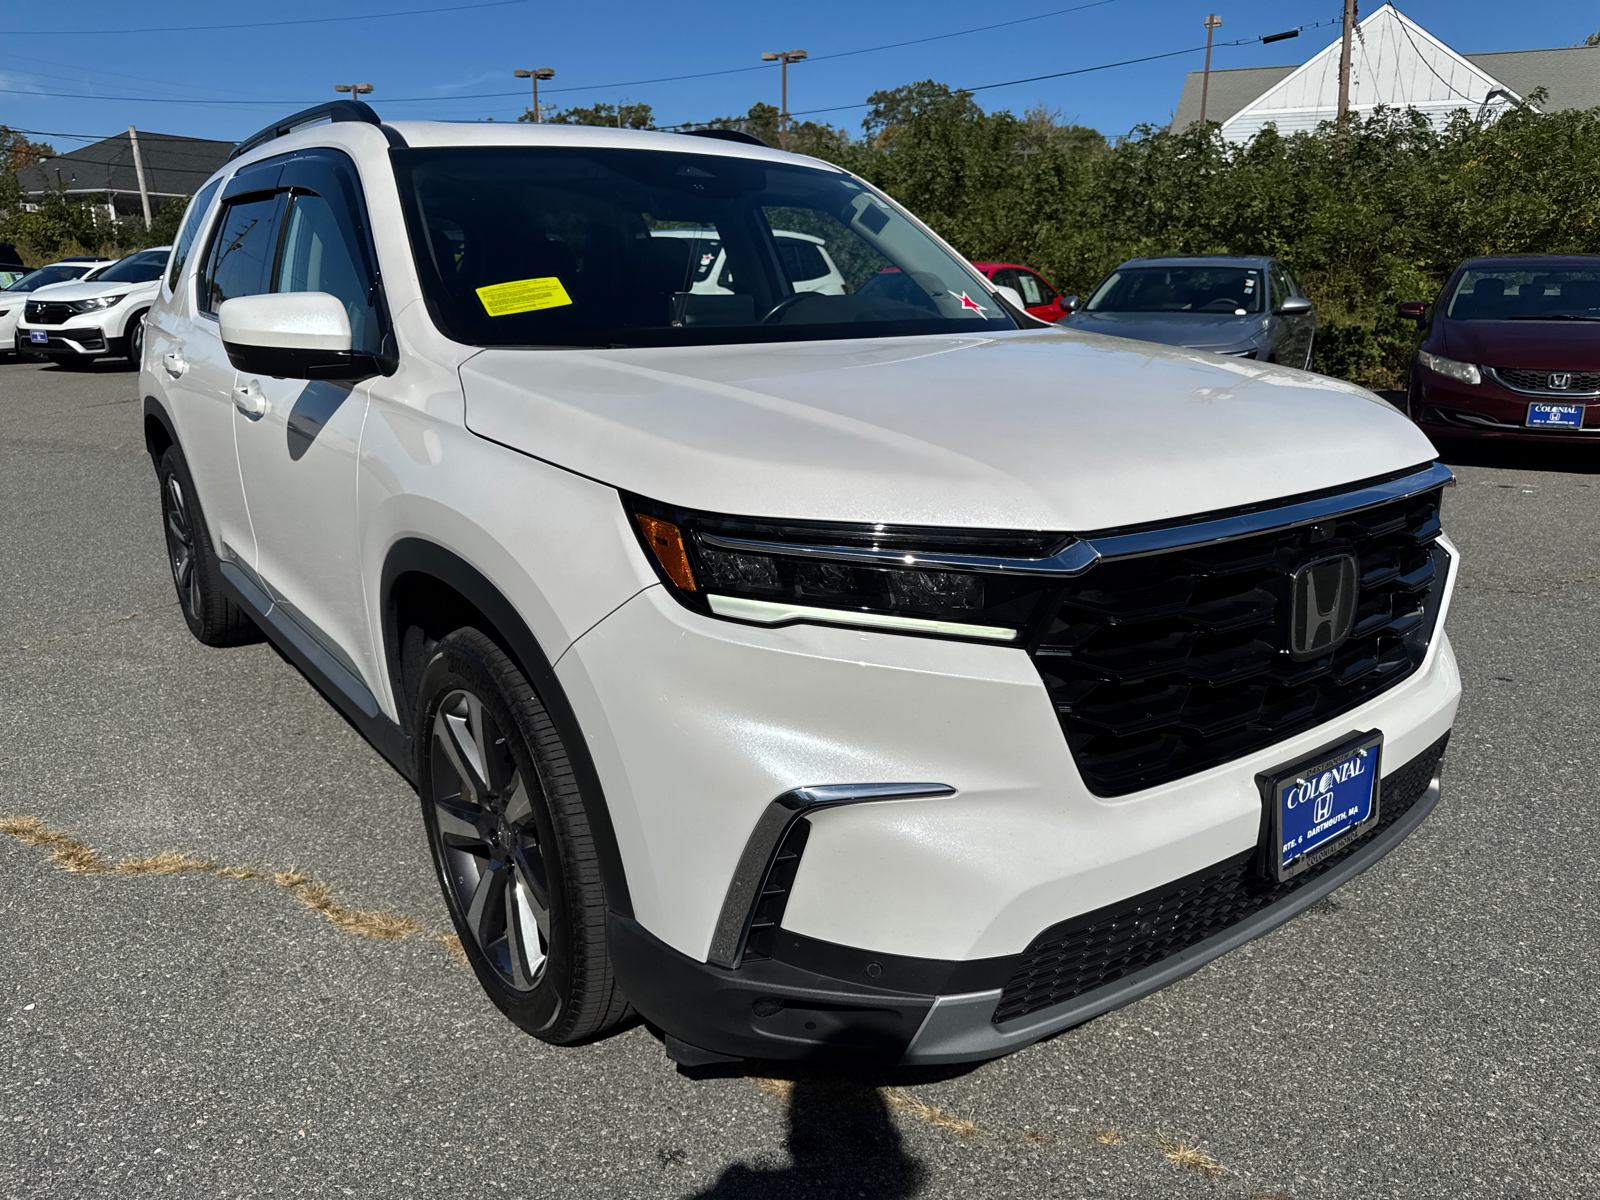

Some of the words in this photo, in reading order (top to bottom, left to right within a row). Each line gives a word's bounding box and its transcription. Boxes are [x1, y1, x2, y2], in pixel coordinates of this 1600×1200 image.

[1535, 405, 1577, 414] COLONIAL
[1287, 758, 1365, 809] COLONIAL
[1282, 839, 1297, 853] RTE.
[1298, 835, 1303, 844] 6
[1307, 812, 1347, 839] DARTMOUTH,
[1348, 805, 1359, 817] MA
[1306, 844, 1337, 867] COLONIAL
